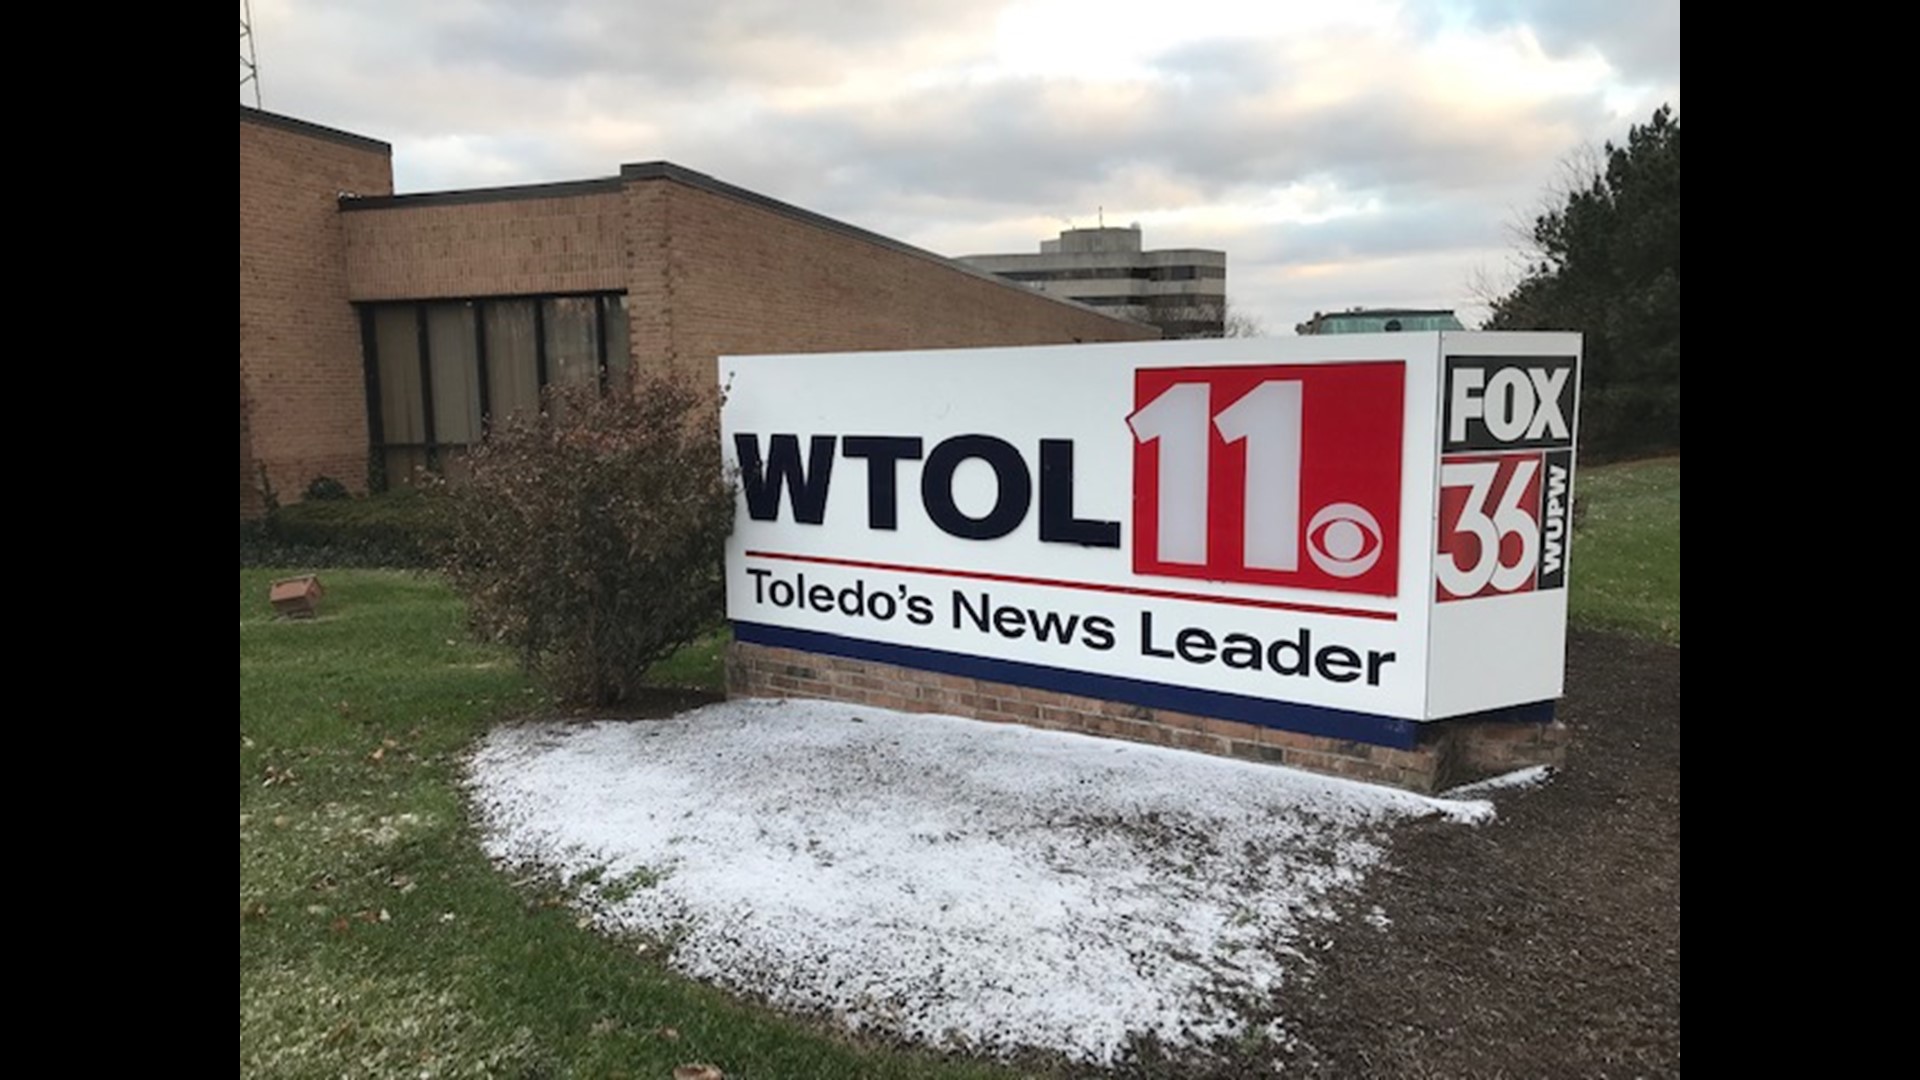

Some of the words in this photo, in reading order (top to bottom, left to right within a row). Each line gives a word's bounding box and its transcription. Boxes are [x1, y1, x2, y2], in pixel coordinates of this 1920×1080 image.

[1450, 366, 1571, 443] FOX
[733, 433, 1121, 549] WTOL
[1126, 379, 1303, 572] 11
[1435, 460, 1540, 597] 36
[1543, 464, 1568, 576] WUPW
[746, 568, 934, 626] Toledo's
[952, 590, 1116, 652] News
[1141, 611, 1396, 687] Leader
